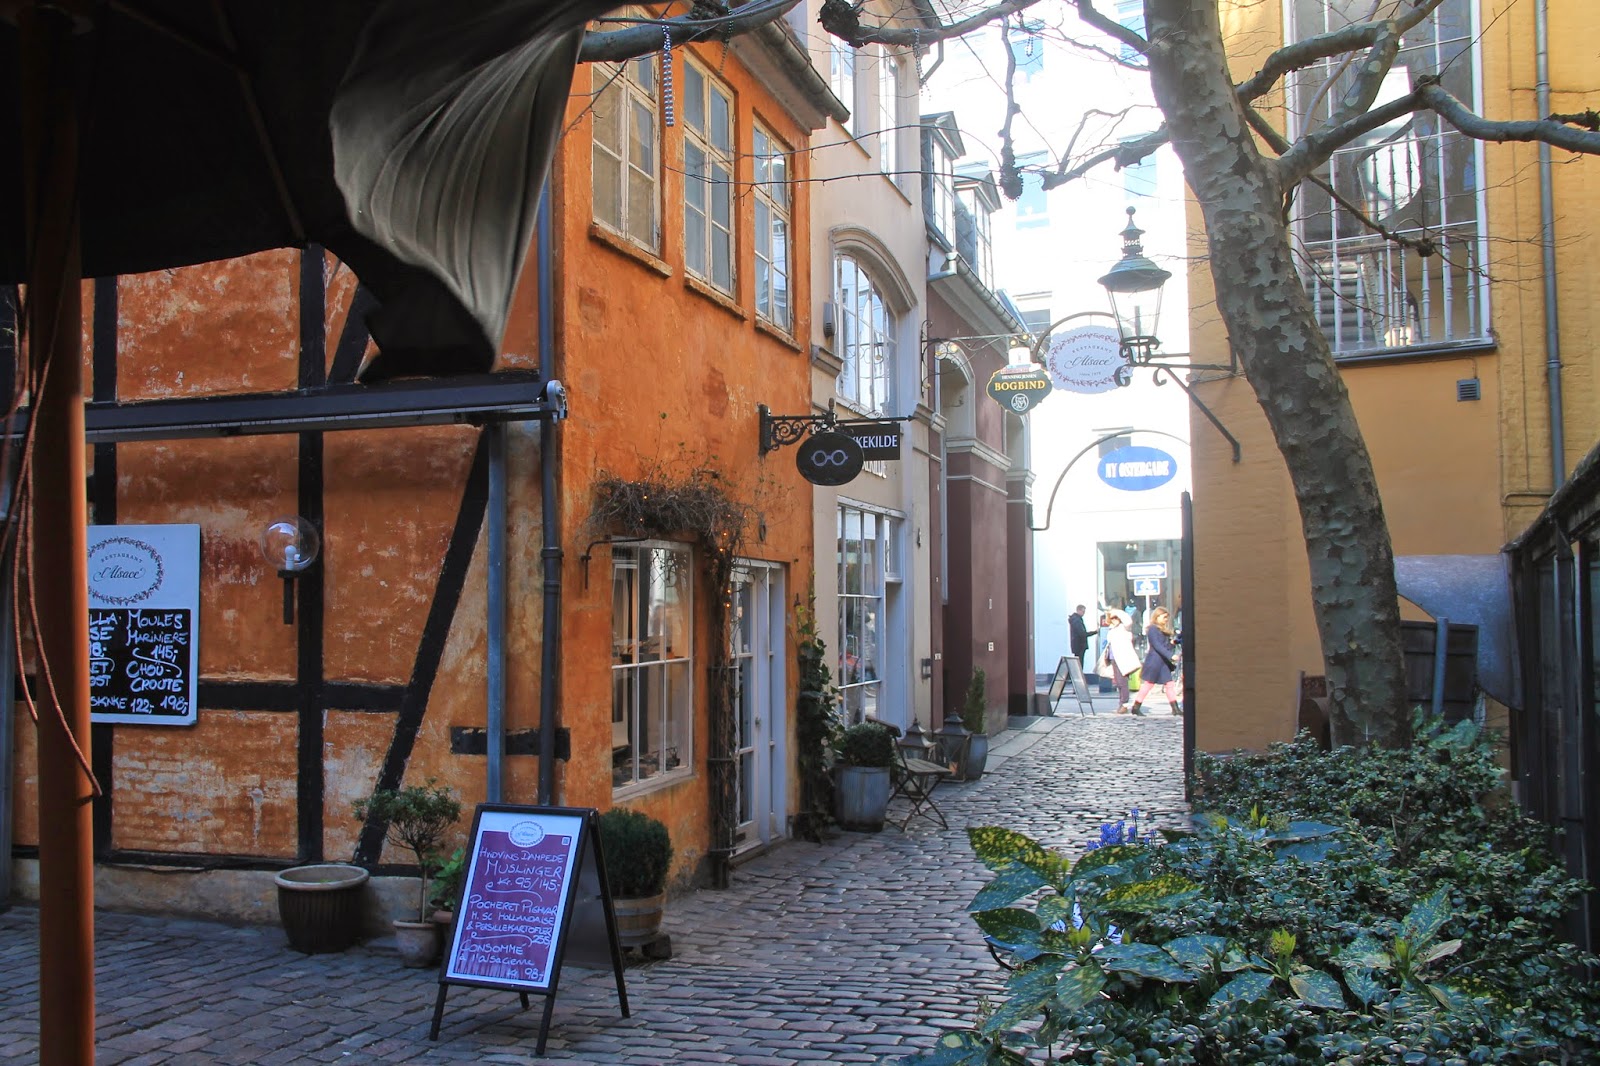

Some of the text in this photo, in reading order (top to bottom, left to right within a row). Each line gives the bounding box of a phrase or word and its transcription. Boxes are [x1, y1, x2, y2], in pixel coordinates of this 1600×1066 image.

[994, 380, 1046, 391] BOGBIND
[852, 434, 898, 449] KEKILDE
[101, 553, 143, 563] RESTAURANT
[126, 609, 183, 629] MOULES
[130, 677, 184, 693] CROUTE
